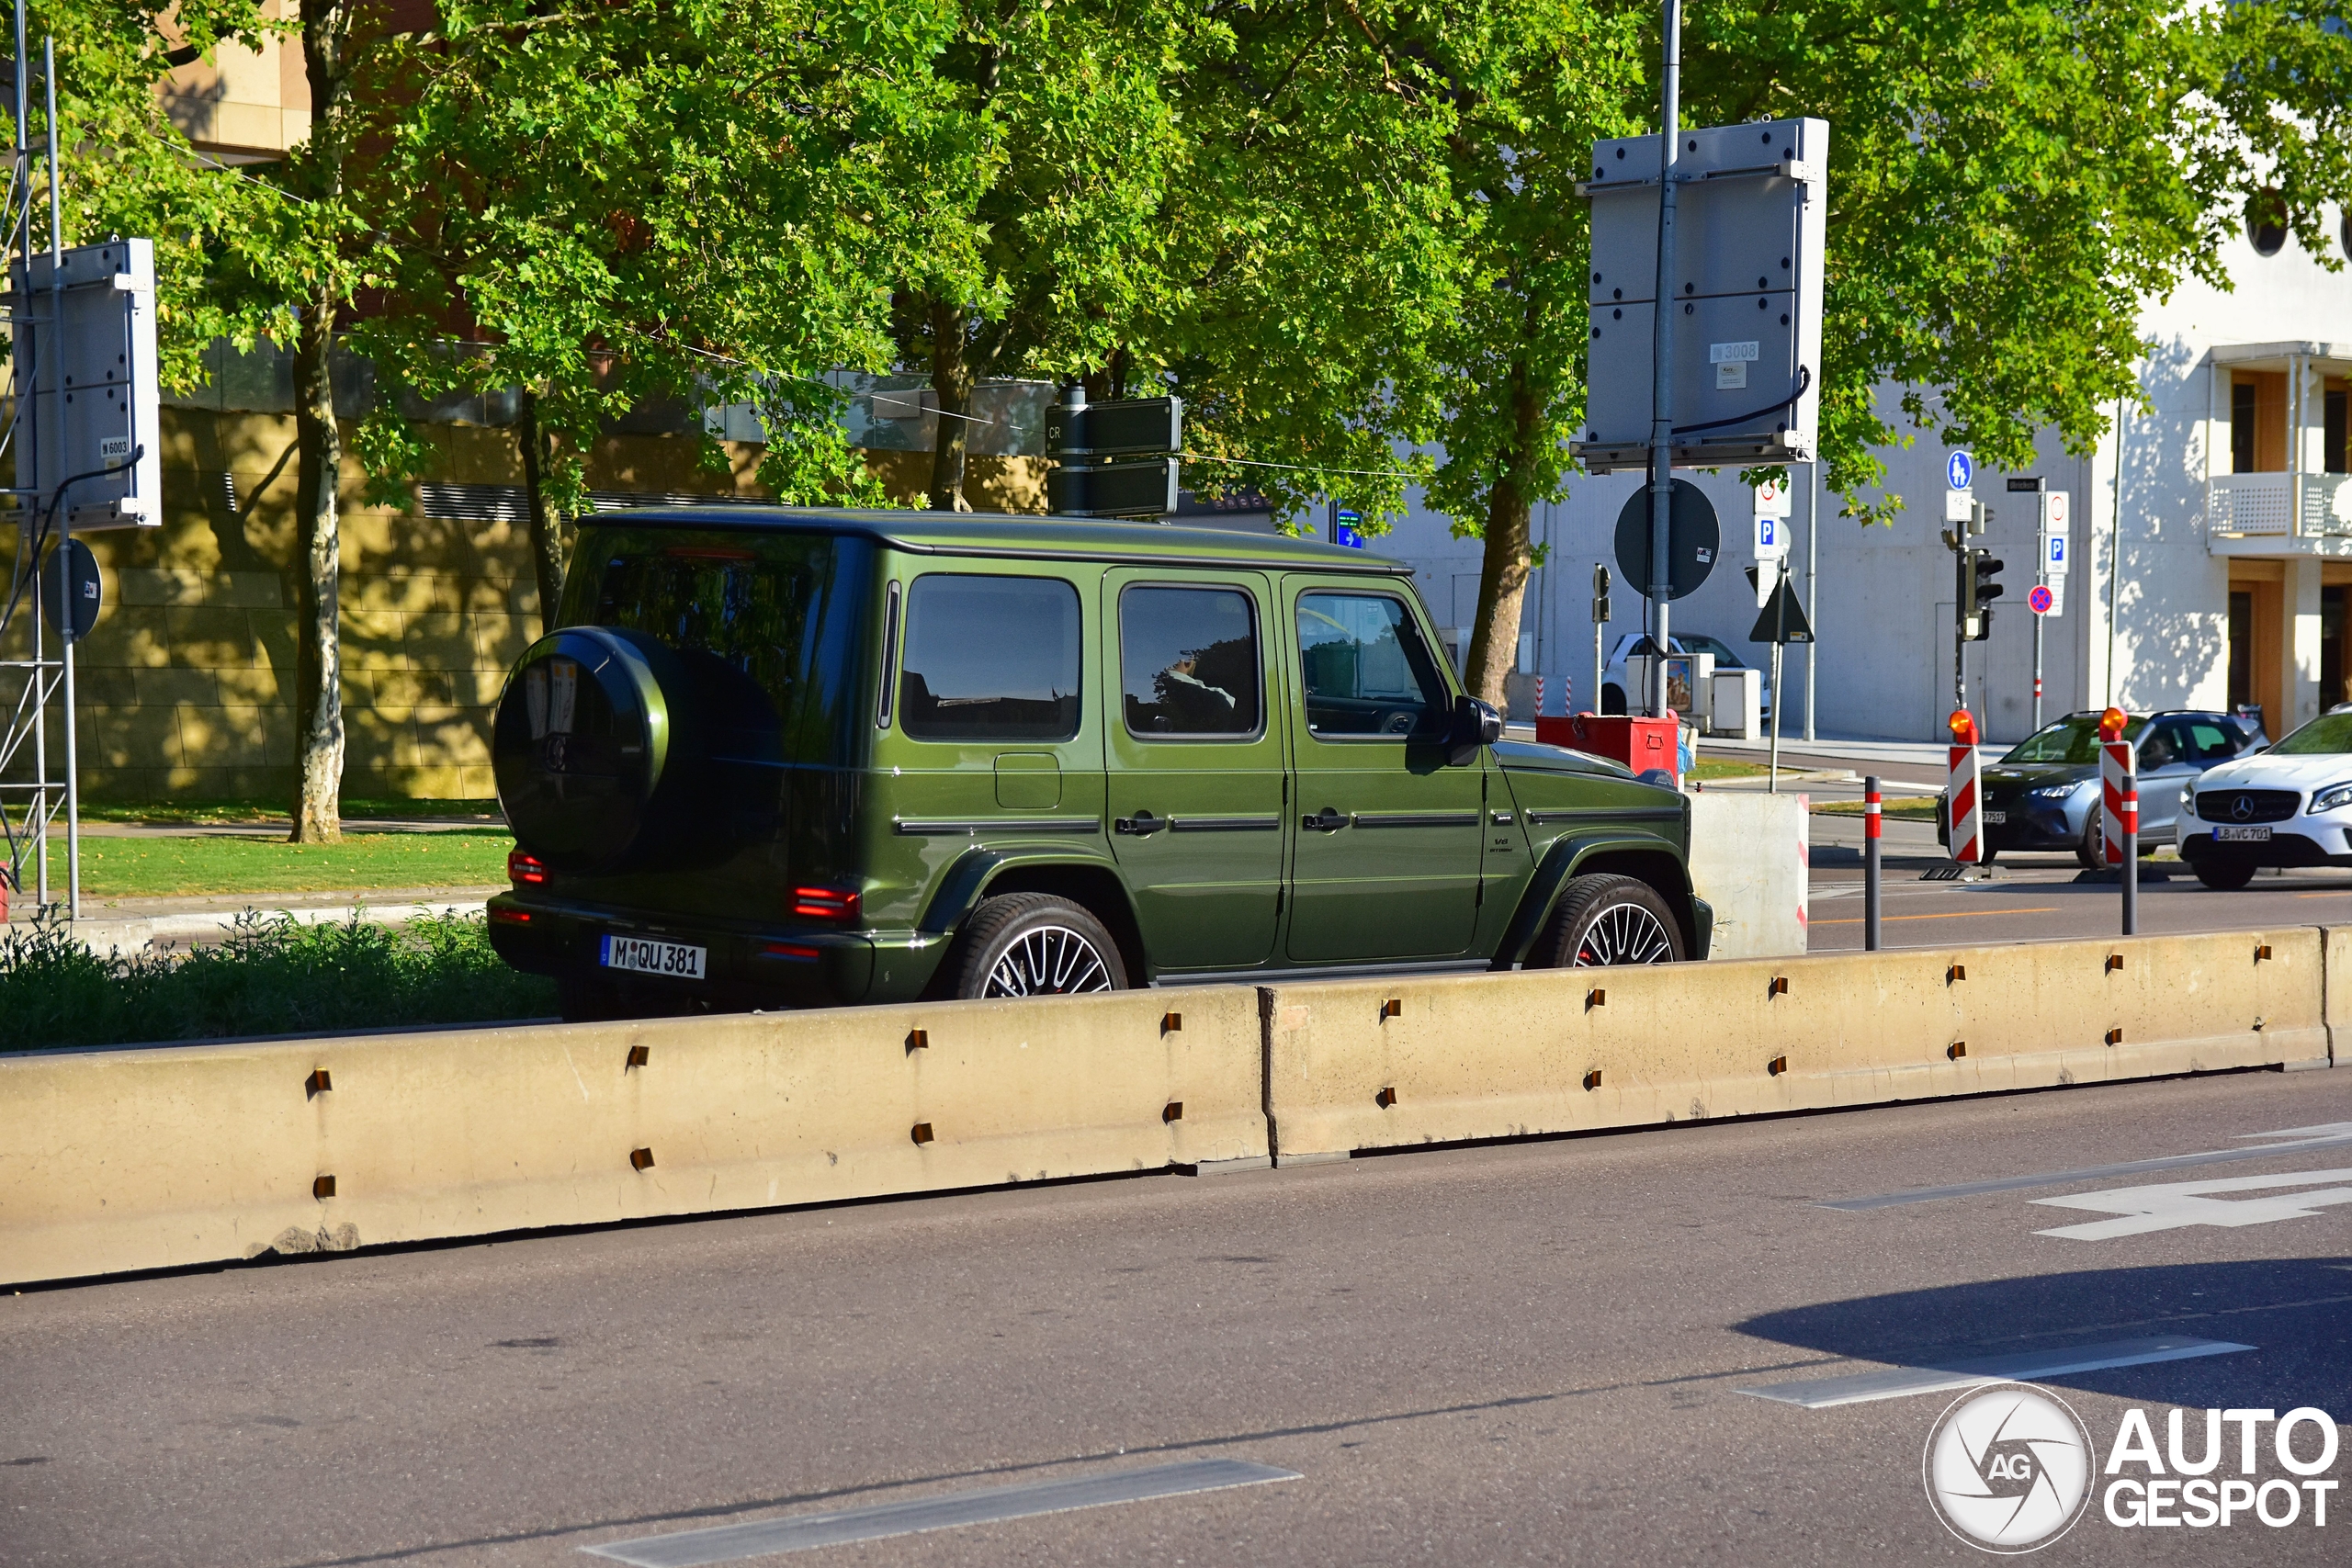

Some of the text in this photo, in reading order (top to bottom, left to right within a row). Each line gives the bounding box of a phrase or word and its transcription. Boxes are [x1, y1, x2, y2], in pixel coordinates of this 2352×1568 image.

[1724, 344, 1756, 359] 3008
[108, 441, 128, 454] 6003
[1762, 522, 1772, 543] P
[2052, 540, 2063, 559] P
[2218, 829, 2268, 840] LB VC 701
[615, 939, 698, 976] M QU 381
